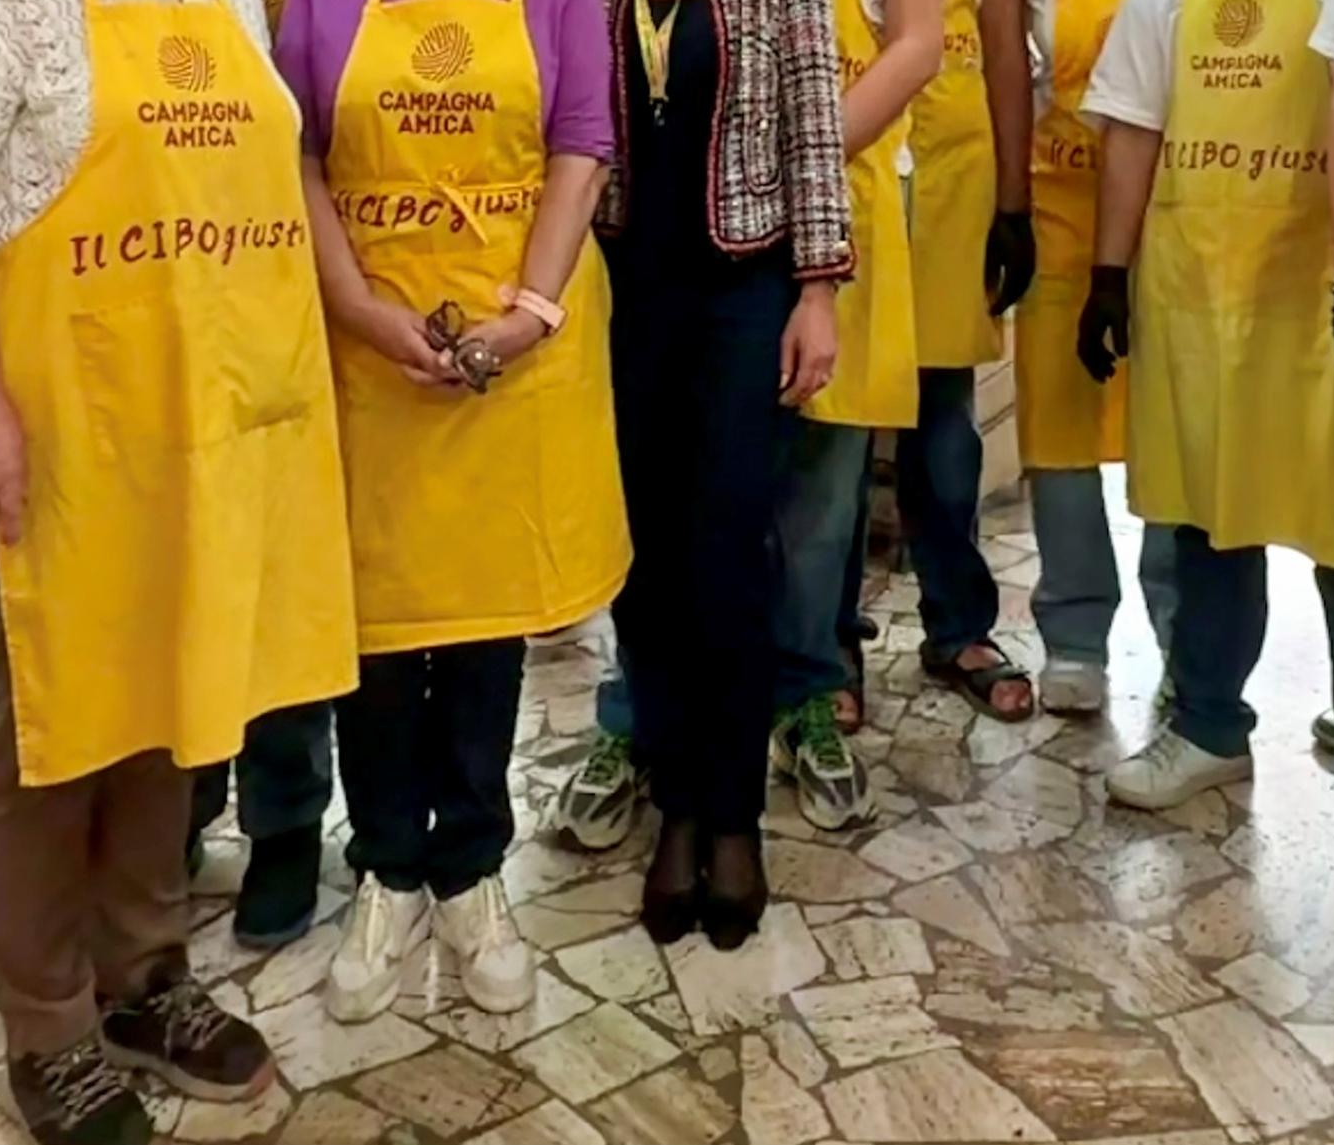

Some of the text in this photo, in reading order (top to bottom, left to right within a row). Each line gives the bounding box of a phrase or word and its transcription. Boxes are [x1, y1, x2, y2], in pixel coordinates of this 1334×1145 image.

[1189, 53, 1283, 72] CAMPAGNA
[1202, 72, 1263, 90] AMICA
[137, 100, 255, 125] CAMPAGNA
[378, 90, 497, 114] CAMPAGNA
[396, 112, 476, 136] AMICA
[163, 125, 237, 148] AMICA
[355, 194, 446, 231] CIBO
[69, 233, 107, 277] Il
[119, 217, 220, 264] CIBO
